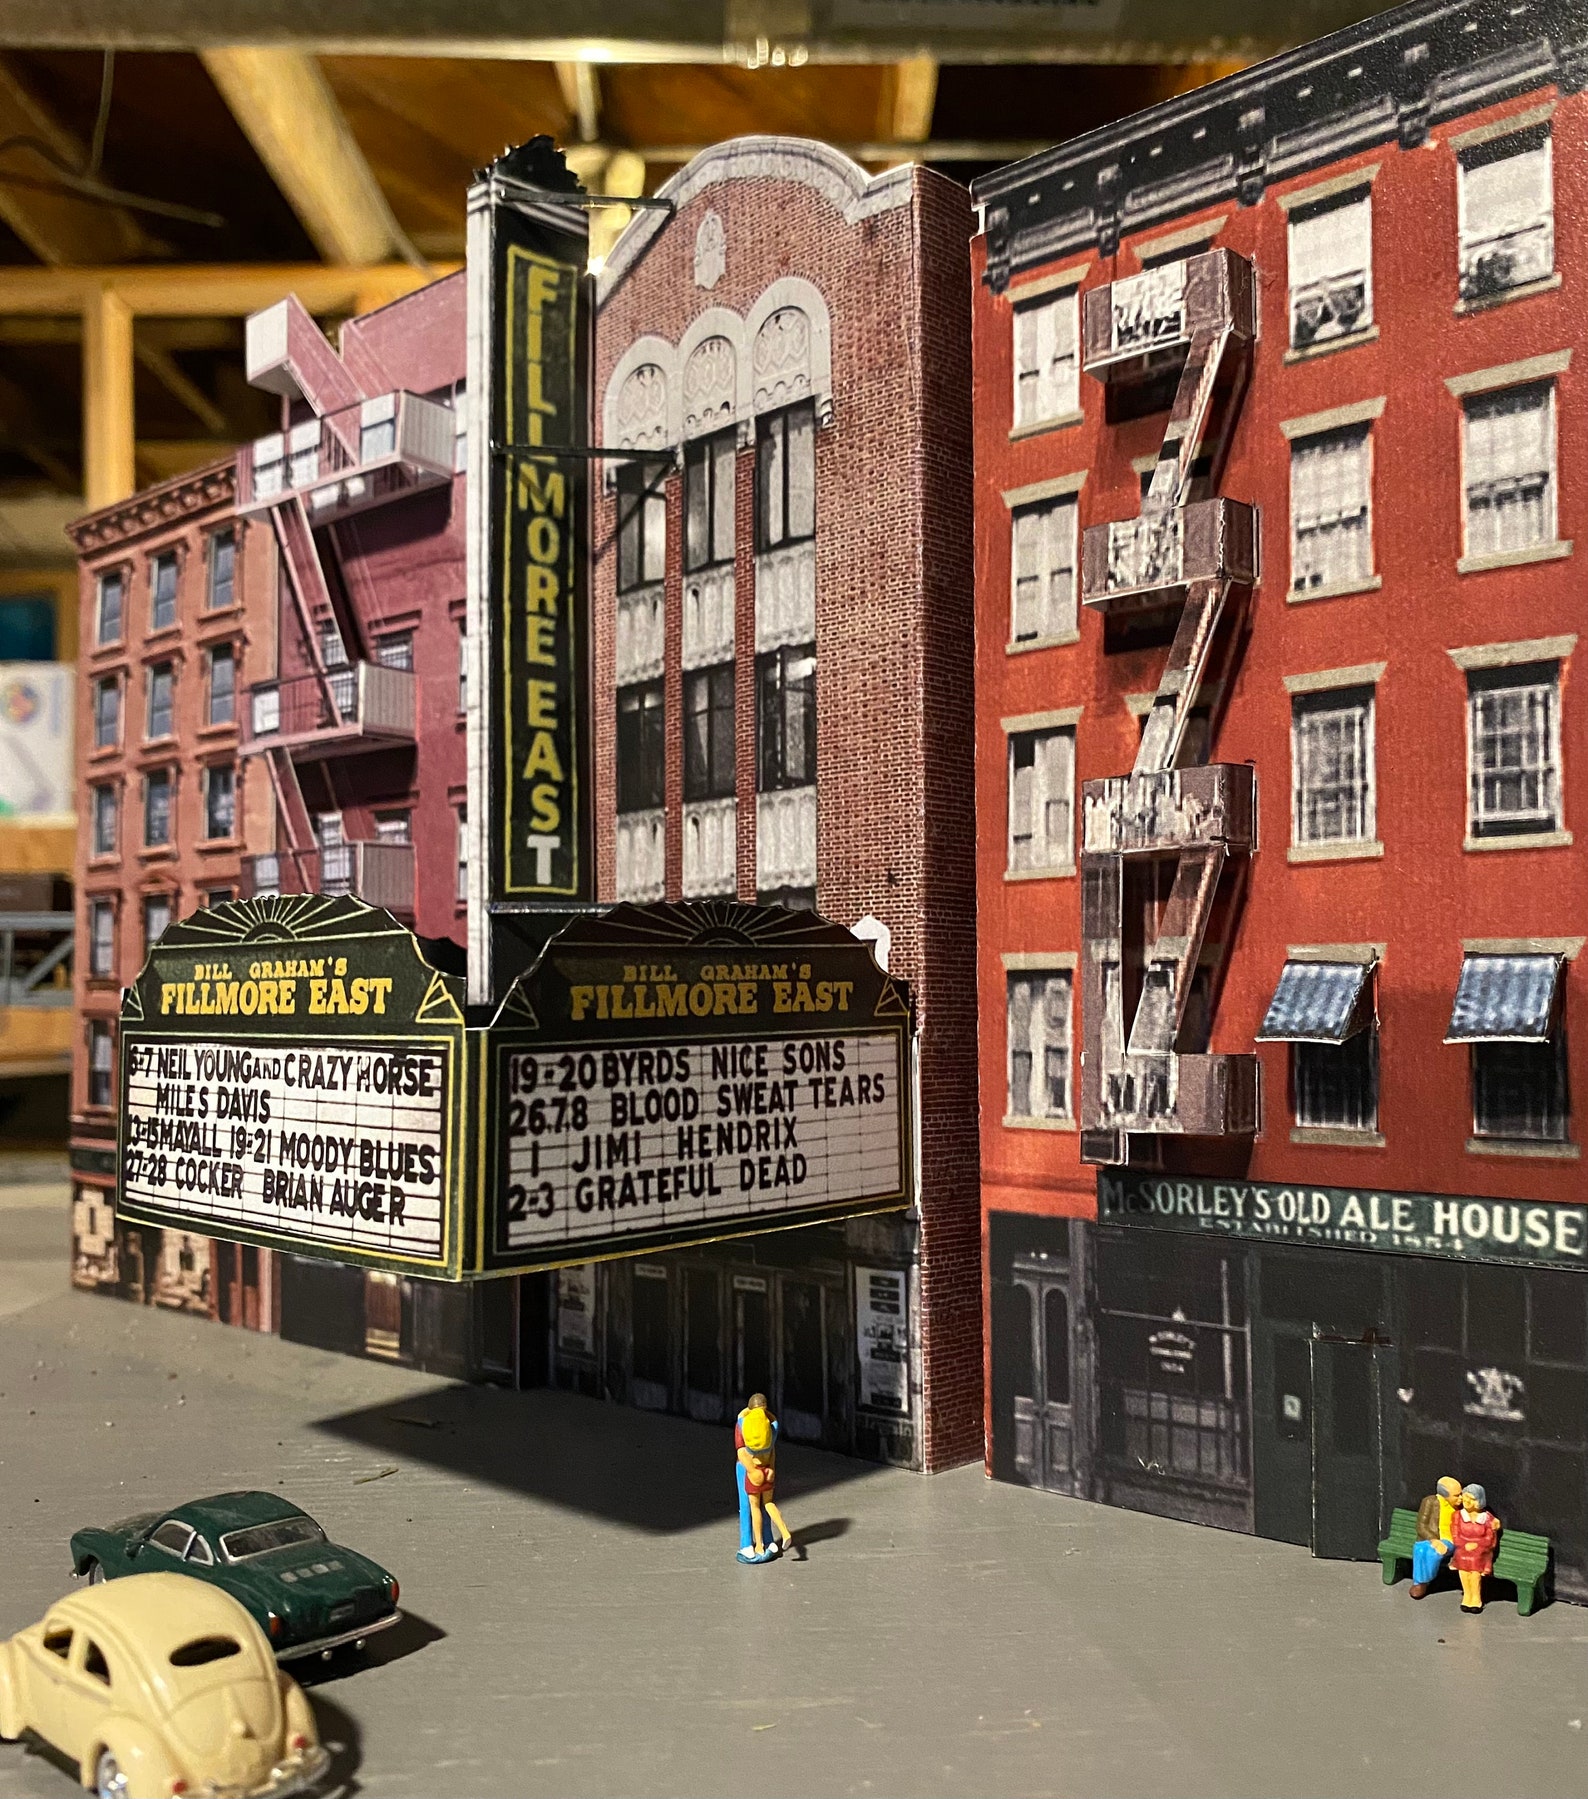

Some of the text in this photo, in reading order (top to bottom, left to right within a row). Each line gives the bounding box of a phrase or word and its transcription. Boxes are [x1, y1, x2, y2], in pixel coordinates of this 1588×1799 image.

[518, 265, 566, 885] FILLMORE EAST
[194, 956, 348, 981] BILL GRAHAM'S
[623, 963, 812, 982] BILL GRAHAM'S
[161, 977, 393, 1015] FILLMORE EAST
[570, 981, 854, 1021] FILLMORE EAST
[157, 1047, 192, 1081] NEIL
[284, 1053, 353, 1091] CRAZY
[356, 1055, 434, 1097] HORSE
[602, 1048, 690, 1088] BYRDS
[712, 1044, 769, 1080] NICE
[783, 1040, 846, 1075] SONS
[156, 1082, 271, 1124] MILES DAVIS
[611, 1087, 699, 1128] BLOOD
[717, 1079, 799, 1117] SWEAT
[808, 1073, 885, 1109] TEARS
[279, 1129, 354, 1175] MOODY
[360, 1138, 435, 1185] BLUES
[572, 1130, 641, 1173] JIMI
[677, 1116, 798, 1161] HENDRIX
[176, 1156, 243, 1200] COCKER
[263, 1168, 324, 1213] BRIAN
[329, 1178, 406, 1227] AUGER
[575, 1161, 722, 1213] GRATEFUL
[740, 1153, 807, 1192] DEAD
[1277, 1189, 1331, 1225] OLD
[1339, 1194, 1416, 1232] ALE
[1432, 1199, 1584, 1256] HOUSE
